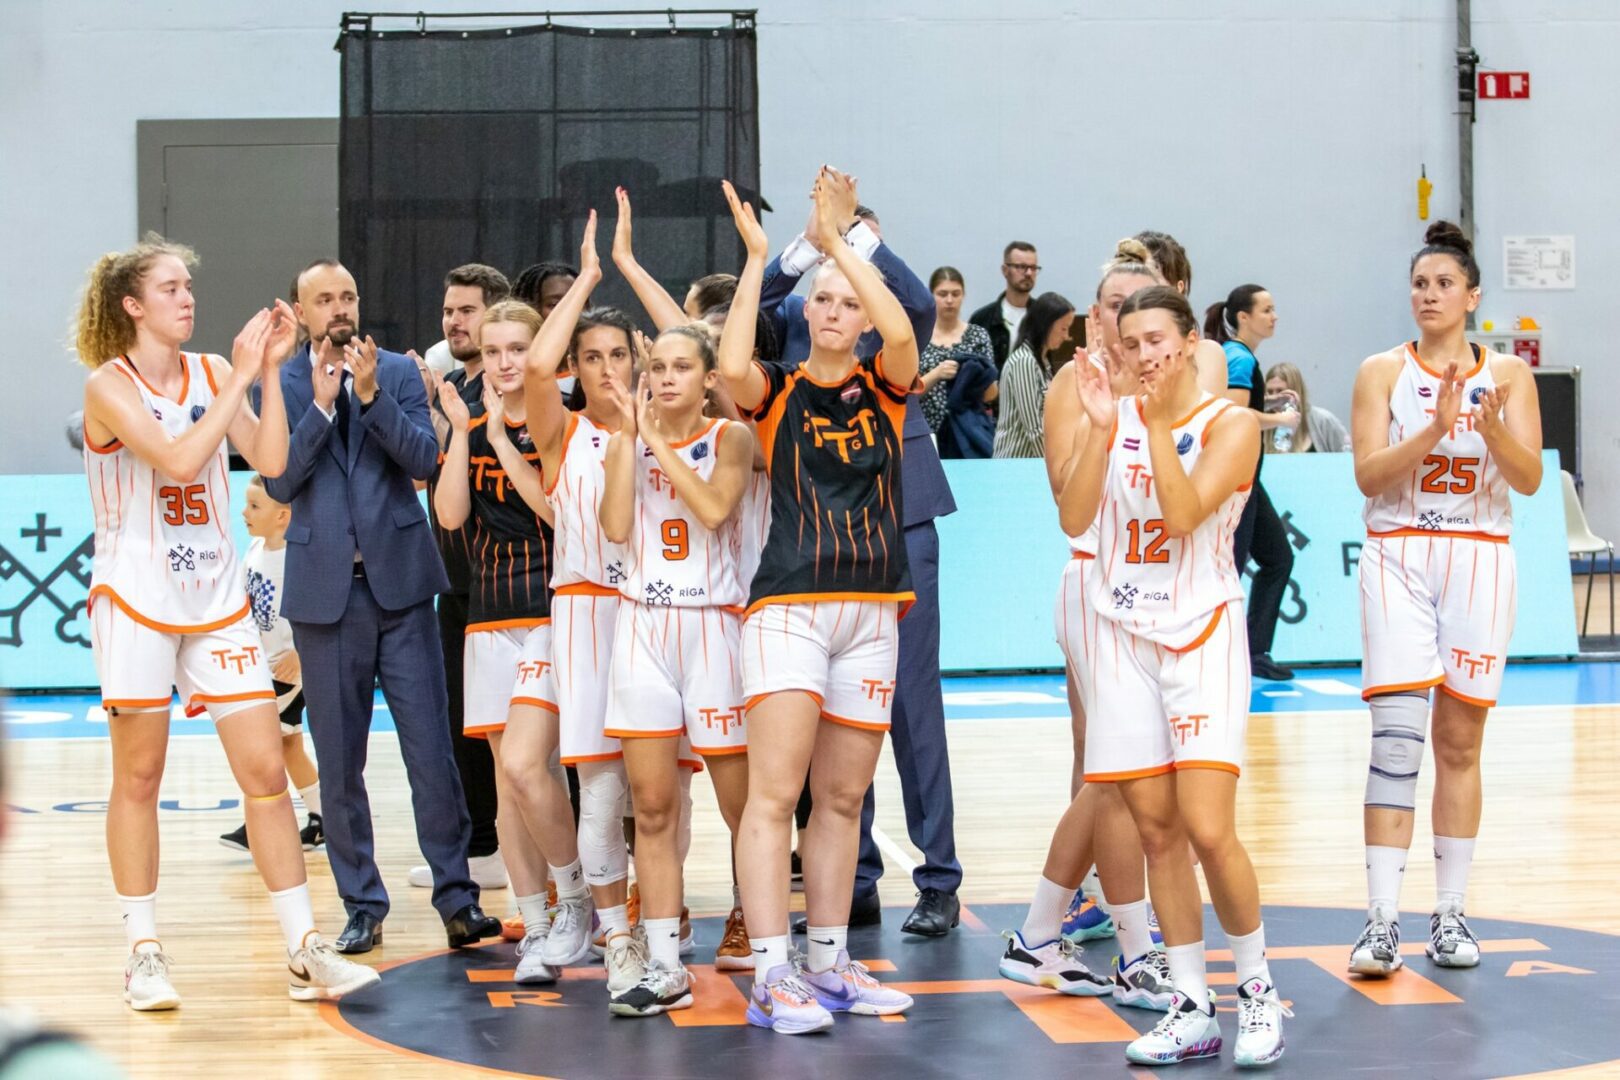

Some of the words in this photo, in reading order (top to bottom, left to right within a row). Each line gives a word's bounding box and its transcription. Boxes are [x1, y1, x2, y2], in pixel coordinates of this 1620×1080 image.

[1126, 464, 1154, 498] TT
[1421, 454, 1480, 495] 25
[159, 484, 210, 526] 35
[661, 519, 690, 561] 9
[1125, 519, 1170, 564] 12
